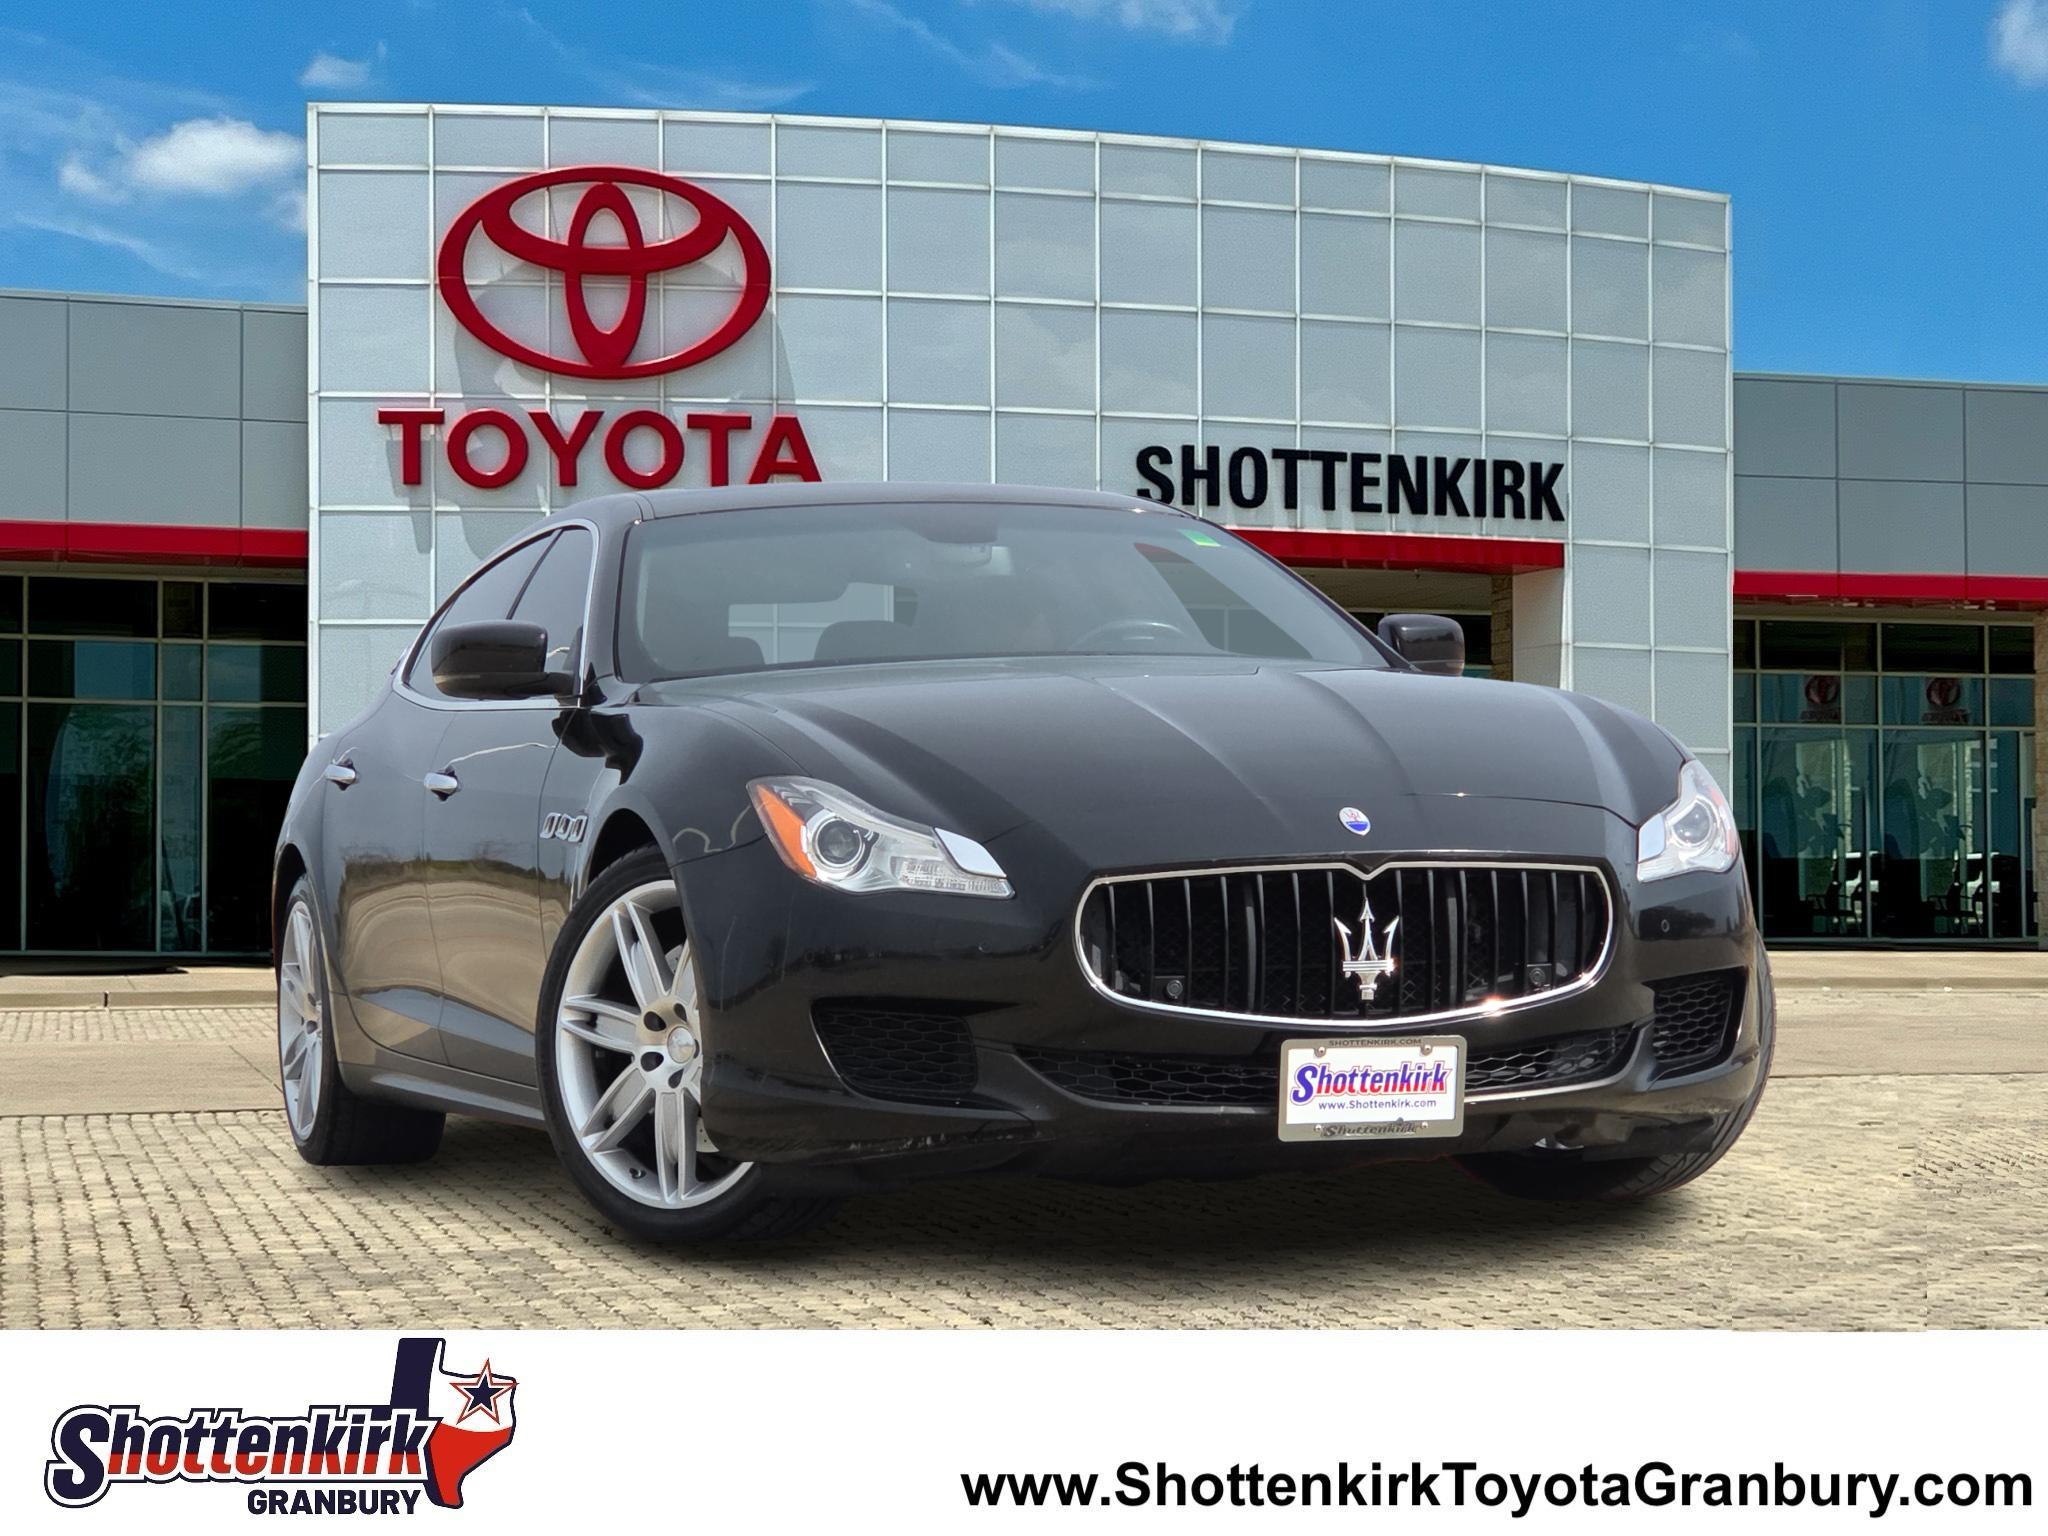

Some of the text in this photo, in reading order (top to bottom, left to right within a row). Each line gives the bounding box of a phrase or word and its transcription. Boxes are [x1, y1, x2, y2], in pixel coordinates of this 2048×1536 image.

[378, 408, 822, 489] TOYOTA
[1136, 445, 1565, 521] SHOTTENKIRK
[1328, 1038, 1422, 1047] SHOTTENKIRK.COM
[1291, 1061, 1450, 1105] Shottenkirk
[1318, 1098, 1437, 1111] www.Shottenkirk.com
